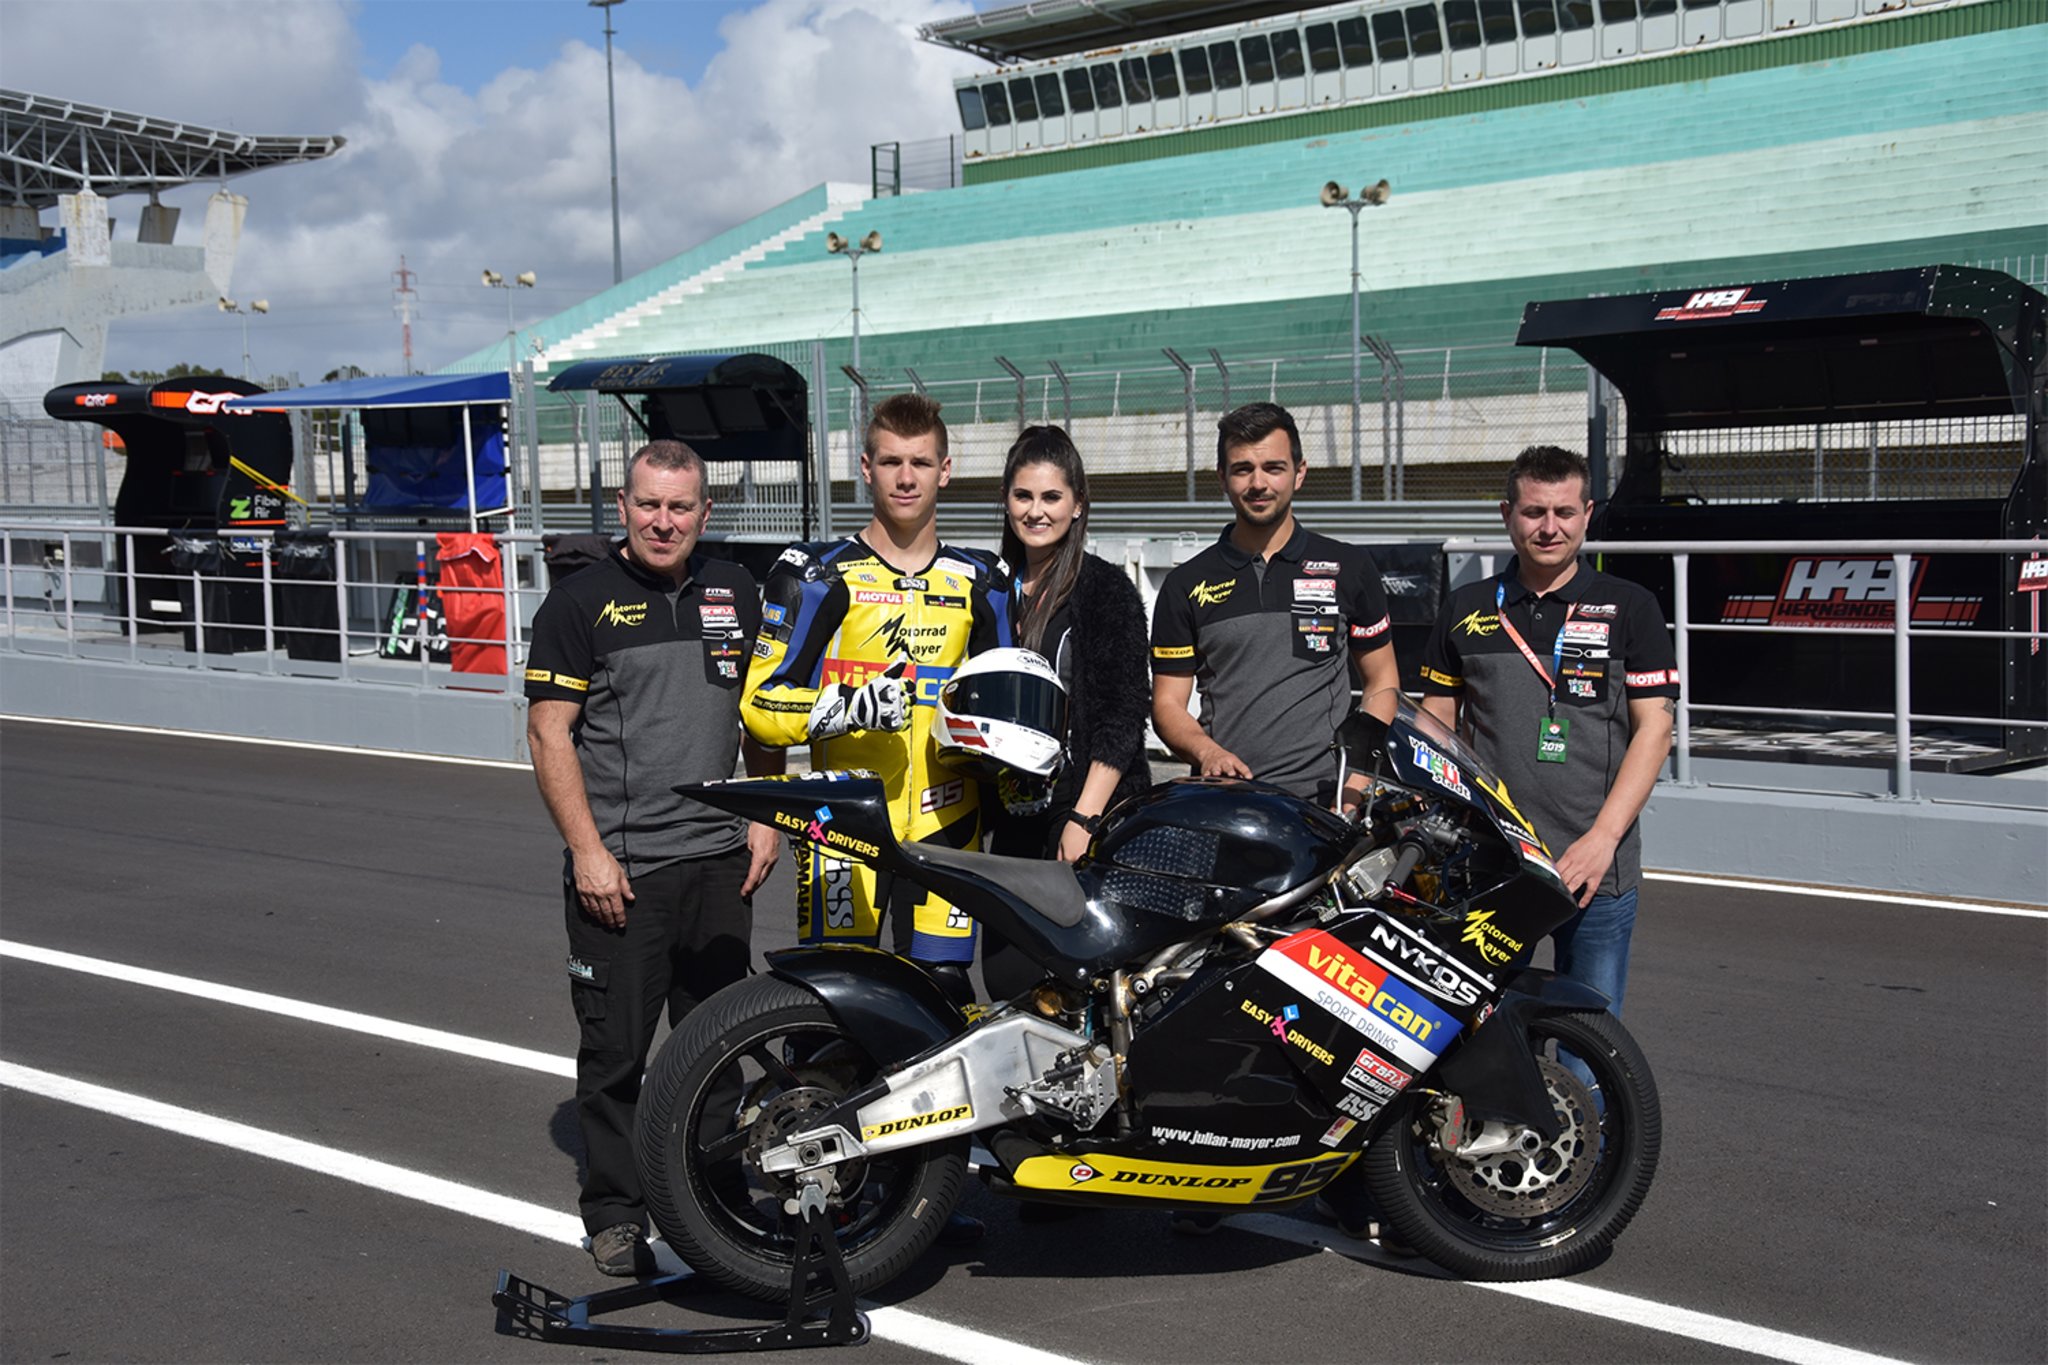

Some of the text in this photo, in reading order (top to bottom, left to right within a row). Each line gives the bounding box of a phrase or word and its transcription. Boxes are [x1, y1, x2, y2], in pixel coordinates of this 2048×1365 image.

[858, 592, 902, 604] MOTUL
[1776, 603, 1896, 618] HERNANDE
[857, 613, 947, 649] Motorrad
[885, 637, 942, 664] Mayer
[1626, 672, 1664, 685] MOTUL
[1541, 741, 1566, 752] 2019
[921, 779, 965, 814] 95
[774, 811, 880, 858] EASY DRIVERS
[1462, 909, 1524, 952] Motorrad
[1461, 928, 1512, 966] Mayer
[1370, 923, 1482, 1005] NYKOS
[1240, 999, 1335, 1066] EASY DRIVERS
[1316, 990, 1399, 1052] SPORT DRINKS
[1349, 1066, 1398, 1098] Design
[878, 1106, 968, 1135] DUNLOP
[1152, 1126, 1301, 1150] www.julian-mayer.com
[1110, 1170, 1252, 1188] DUNLOP
